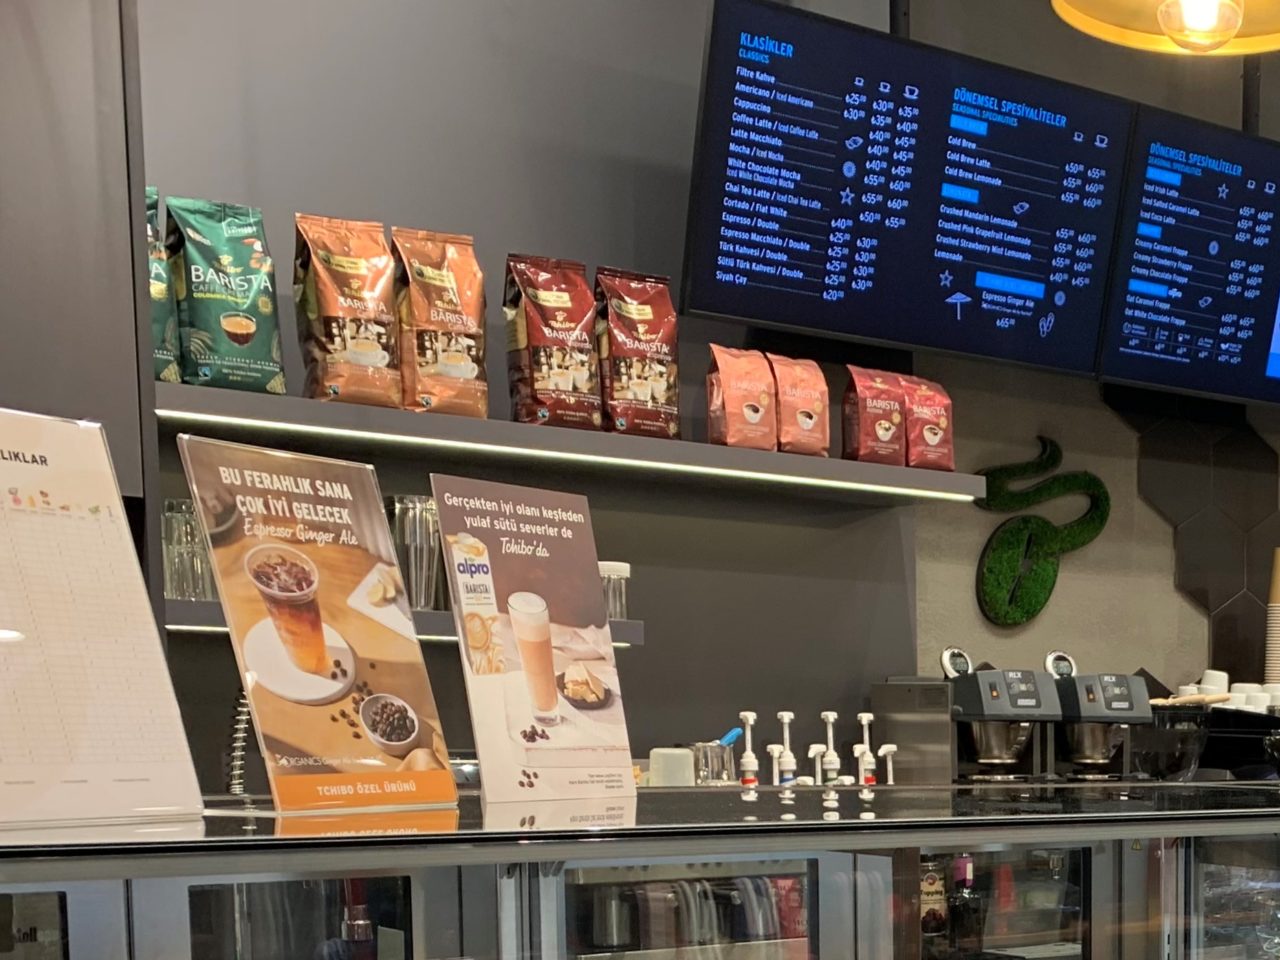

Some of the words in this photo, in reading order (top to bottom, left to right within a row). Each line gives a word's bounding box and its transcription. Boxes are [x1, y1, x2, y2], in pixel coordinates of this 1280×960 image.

[740, 31, 794, 58] KLASİKLER
[738, 48, 770, 64] CLASSICS
[736, 66, 754, 79] Filtre
[755, 71, 775, 83] Kahve
[735, 82, 770, 98] Americano
[733, 96, 771, 113] Cappuccino
[953, 87, 999, 111] DÖNEMSEL
[1000, 99, 1068, 128] SPESİYALİTELER
[730, 127, 749, 139] Latte
[749, 131, 783, 146] Macchiato
[947, 135, 961, 146] Cold
[961, 138, 977, 150] Brew
[729, 142, 751, 155] Mocha
[946, 150, 960, 161] Cold
[960, 153, 975, 165] Brew
[975, 156, 991, 169] Latte
[727, 157, 747, 169] White
[747, 161, 780, 176] Chocolate
[780, 168, 801, 181] Mocha
[944, 165, 957, 177] Cold
[958, 168, 973, 180] Brew
[973, 172, 1002, 187] Lemonade
[723, 196, 750, 210] Cortado
[755, 203, 768, 214] Flat
[769, 206, 788, 218] White
[939, 203, 963, 217] Crushed
[963, 208, 990, 223] Mandarin
[990, 214, 1018, 228] Lemonade
[721, 211, 751, 226] Espresso
[756, 218, 780, 231] Double
[720, 226, 750, 240] Espresso
[750, 231, 783, 246] Macchiato
[788, 239, 811, 252] Double
[937, 219, 961, 232] Crushed
[975, 226, 1004, 241] Grapefruit
[1003, 231, 1032, 246] Lemonade
[719, 240, 734, 252] Türk
[734, 244, 760, 257] Kahvesi
[765, 249, 788, 262] Double
[934, 248, 963, 262] Lemonade
[936, 233, 960, 247] Crushed
[960, 238, 991, 253] Strawberry
[1004, 246, 1032, 261] Lemonade
[715, 270, 734, 283] Siyah
[734, 274, 748, 286] Çay
[717, 255, 735, 267] Sütlü
[736, 258, 751, 269] Türk
[751, 262, 776, 275] Kahvesi
[781, 267, 804, 279] Double
[190, 264, 273, 293] BARISTA
[544, 327, 589, 342] BARISTA
[625, 338, 670, 353] BARISTA
[866, 397, 900, 411] BARISTA
[912, 404, 947, 417] BARISTA
[218, 466, 242, 486] BU
[242, 469, 314, 496] FERAHLIK
[315, 479, 353, 501] SANA
[235, 494, 268, 517] ÇOK
[267, 494, 291, 518] İYİ
[292, 502, 353, 525] GELECEK
[444, 492, 499, 512] Gerçekten
[499, 499, 515, 516] iyi
[515, 503, 540, 517] olanı
[541, 506, 585, 524] keşfeden
[243, 517, 294, 541] Espresso
[296, 524, 336, 548] Ginger
[338, 528, 359, 546] Ale
[463, 514, 491, 529] yulaf
[493, 517, 518, 533] sütü
[519, 522, 560, 537] severler
[560, 525, 574, 539] de
[499, 536, 551, 558] Tchibo'da
[456, 558, 490, 579] alpro
[316, 784, 354, 796] TCHIBO
[356, 781, 383, 795] ÖZEL
[383, 779, 417, 794] ÜRÜNÜ
